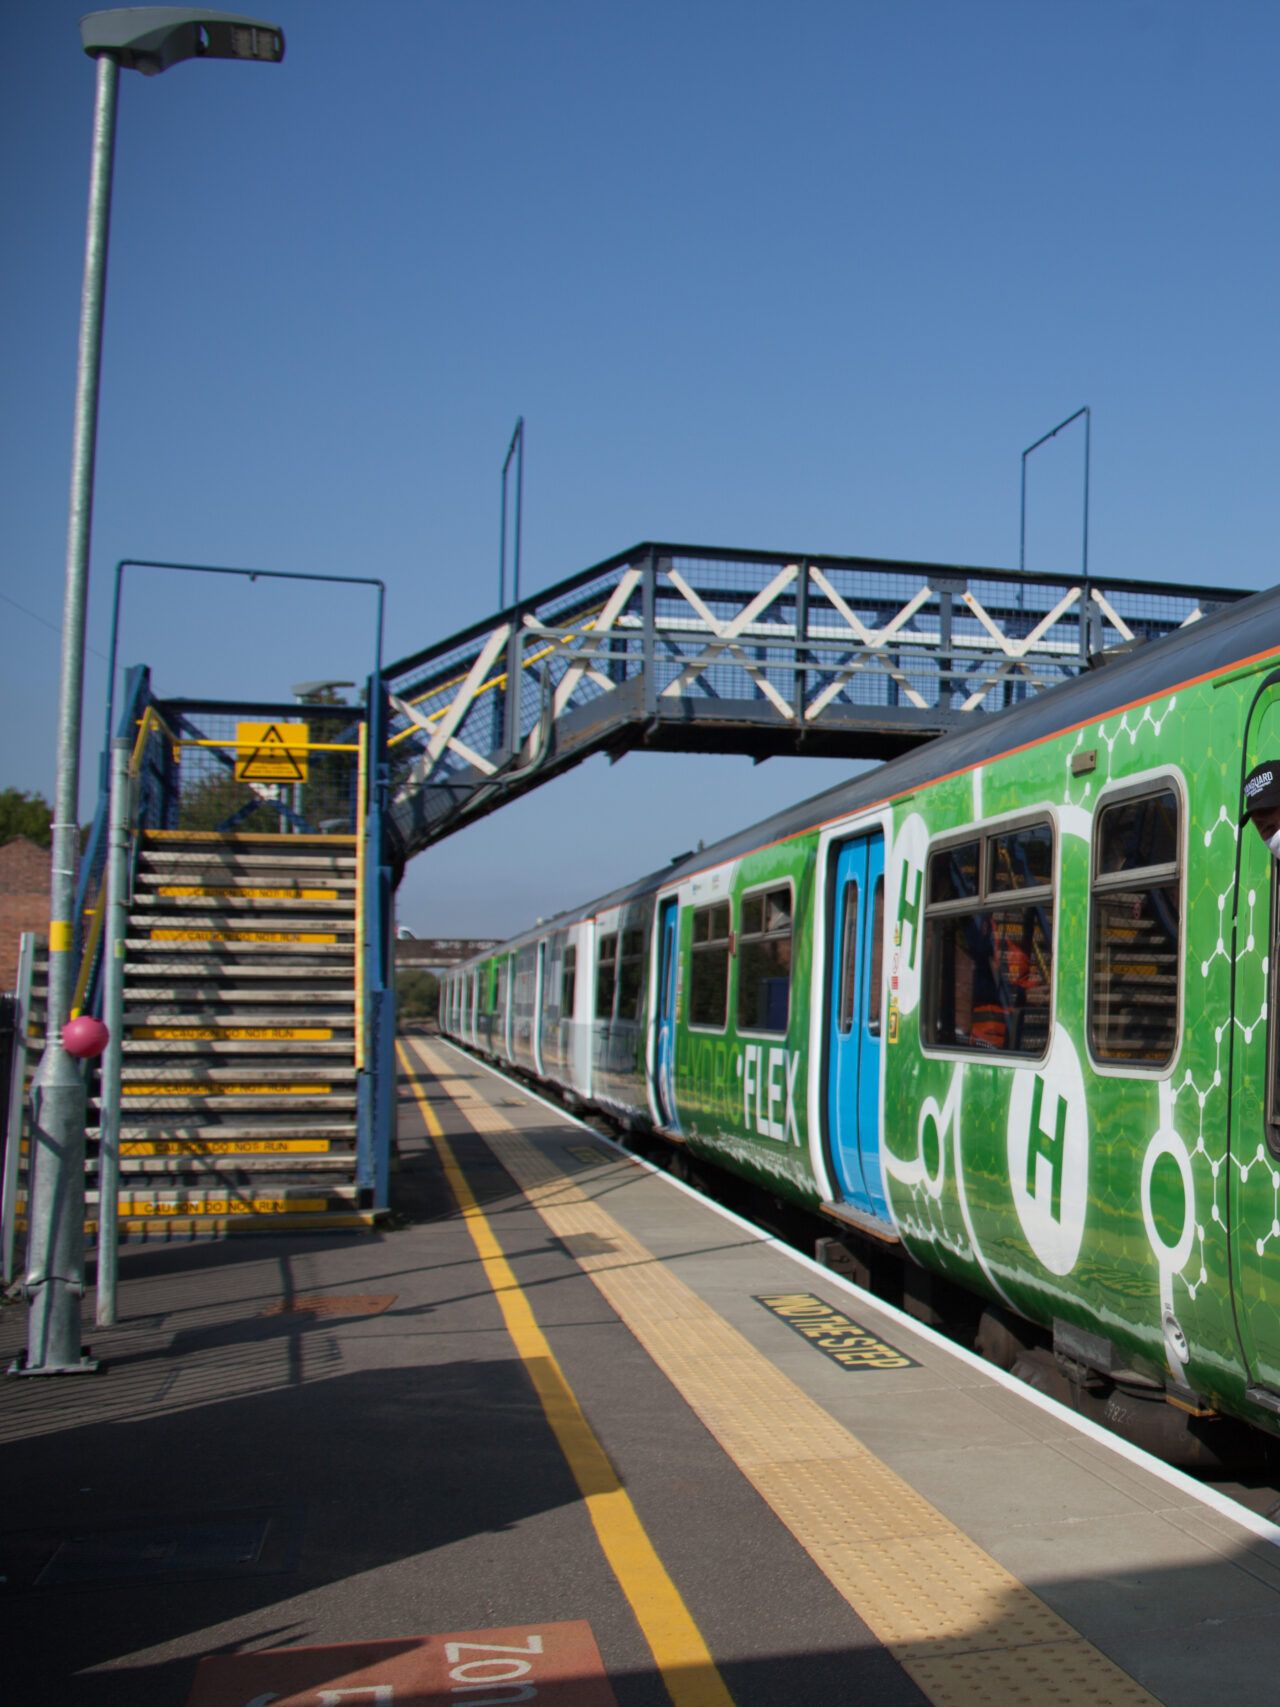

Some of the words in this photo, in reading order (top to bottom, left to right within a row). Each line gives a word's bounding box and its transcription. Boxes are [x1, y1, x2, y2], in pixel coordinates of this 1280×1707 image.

[678, 1036, 741, 1126] HYDRO
[743, 1044, 801, 1148] FLEX
[212, 1142, 229, 1152] DO
[234, 1142, 261, 1151] NOT
[264, 1142, 288, 1151] RUN
[205, 1202, 224, 1212] DO
[259, 1201, 284, 1211] RUN
[757, 1294, 834, 1317] MIND
[789, 1315, 866, 1337] THE
[817, 1337, 911, 1368] STEP
